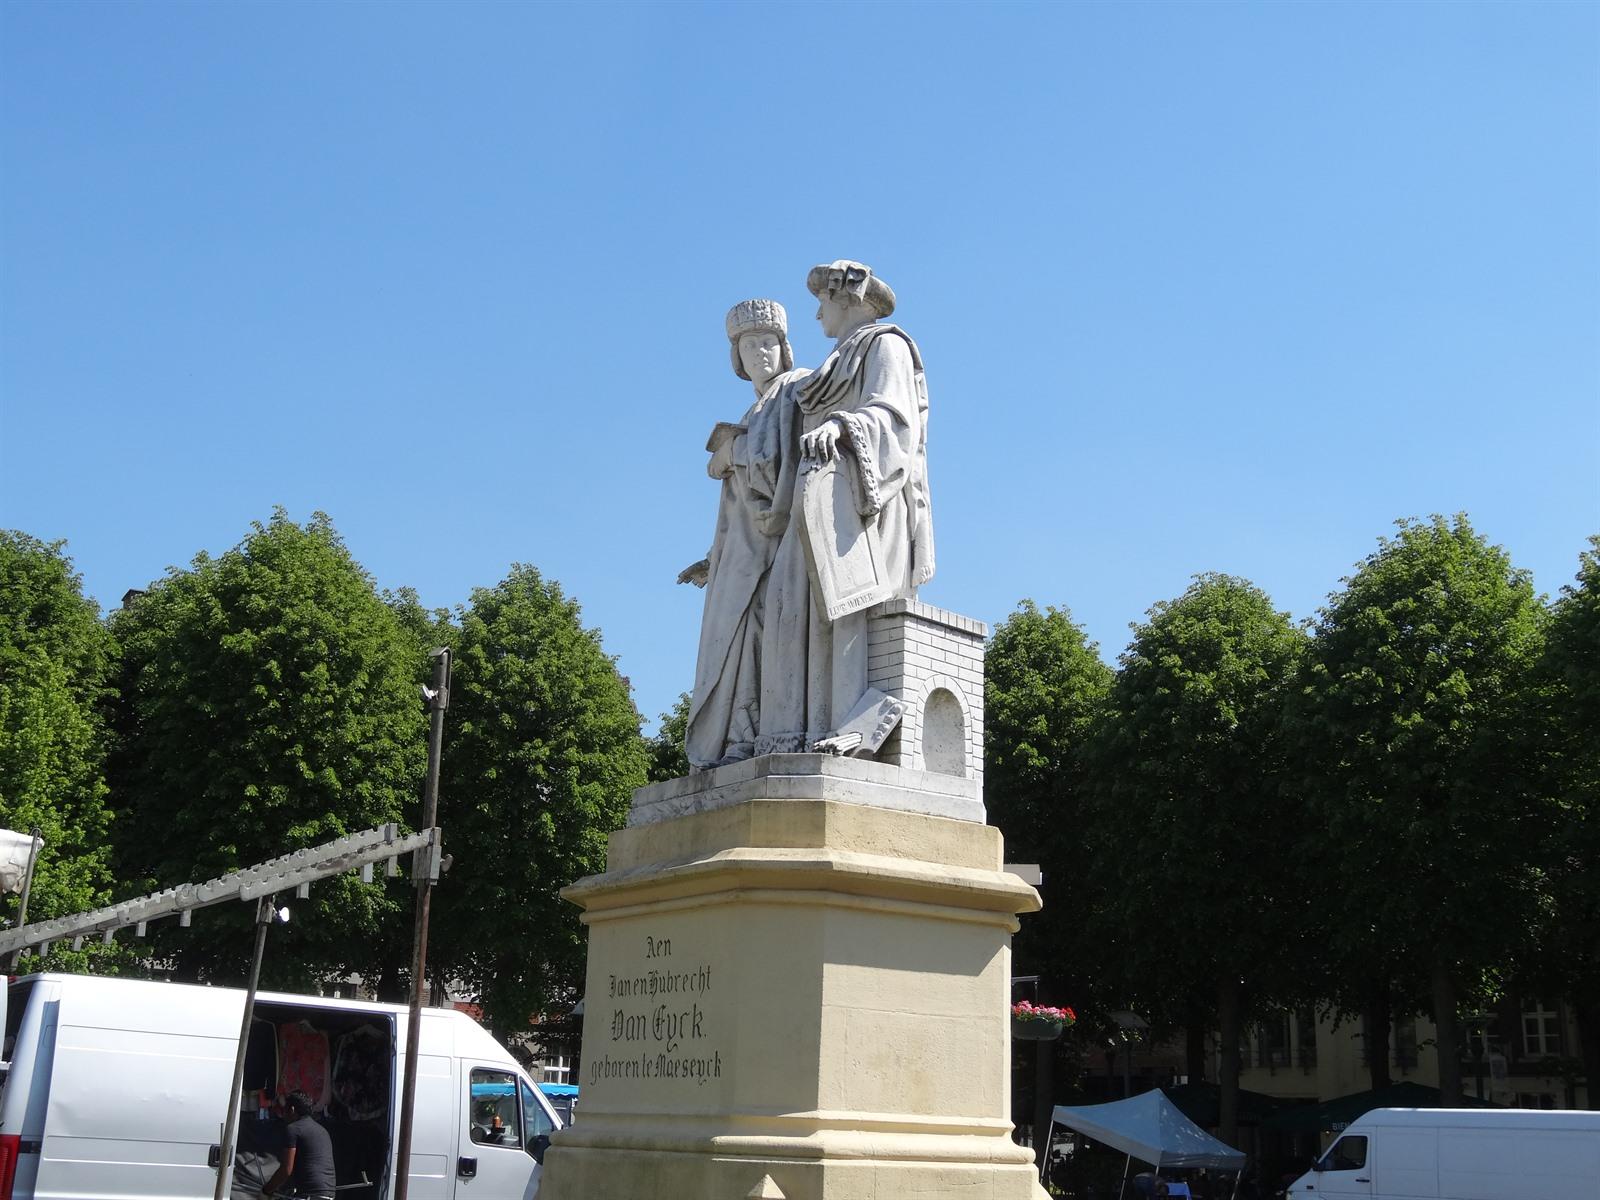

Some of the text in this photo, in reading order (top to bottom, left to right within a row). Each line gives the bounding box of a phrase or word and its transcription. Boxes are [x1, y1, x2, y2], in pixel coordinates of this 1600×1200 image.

[633, 978, 647, 996] en
[648, 965, 712, 1004] Hubrecht
[611, 1009, 647, 1042] Van
[590, 1054, 639, 1085] geboren
[654, 1050, 722, 1085] Maeseyck
